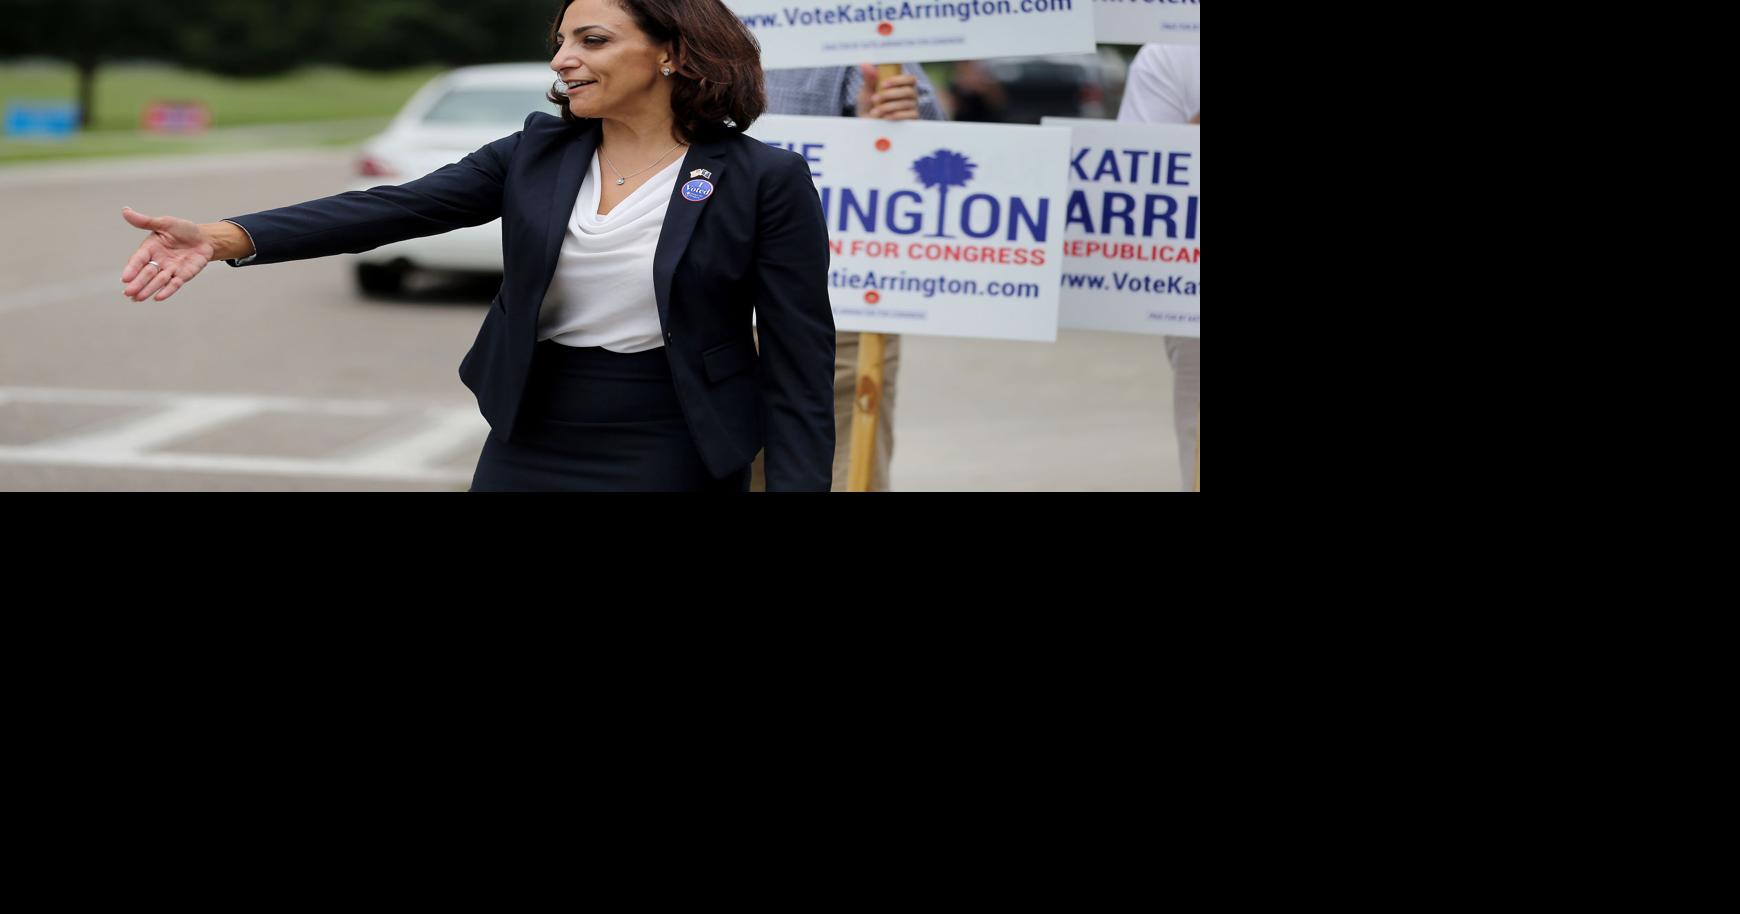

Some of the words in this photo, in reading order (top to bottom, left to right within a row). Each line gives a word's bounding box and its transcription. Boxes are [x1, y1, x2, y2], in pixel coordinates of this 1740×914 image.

[739, 0, 1072, 28] ww.VoteKatieArrington.com
[1069, 147, 1192, 187] KATIE
[686, 184, 711, 195] Voted
[1065, 189, 1199, 240] ARRI
[851, 240, 899, 258] FOR
[907, 242, 1046, 266] CONGRESS
[828, 267, 1039, 298] tieArrington.com
[1060, 272, 1200, 296] ww.VoteKa
